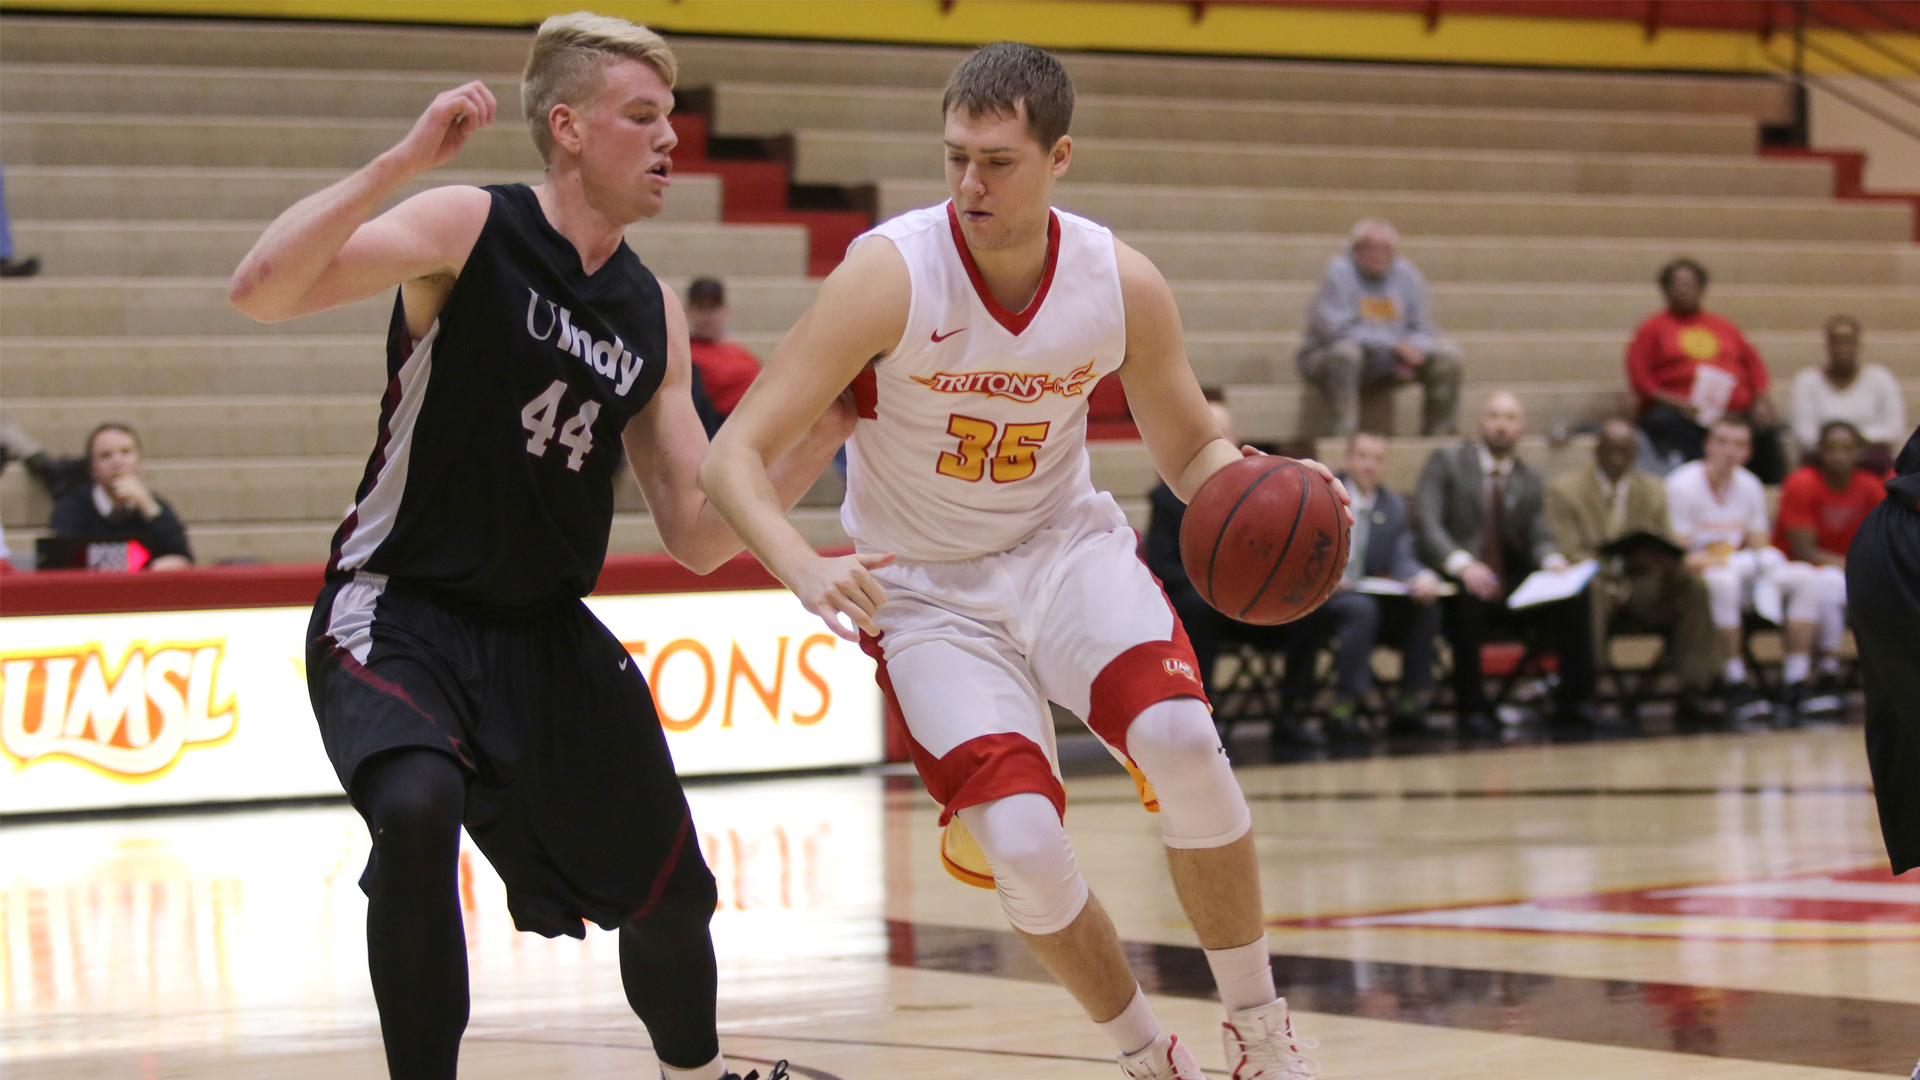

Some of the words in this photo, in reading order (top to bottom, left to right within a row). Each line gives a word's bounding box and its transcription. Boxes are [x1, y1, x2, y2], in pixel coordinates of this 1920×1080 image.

[526, 287, 644, 397] UIndy
[931, 371, 1050, 404] TRITONS
[521, 379, 601, 472] 44
[0, 639, 238, 780] UMSL
[622, 633, 837, 732] ONS
[1163, 658, 1196, 682] UMS
